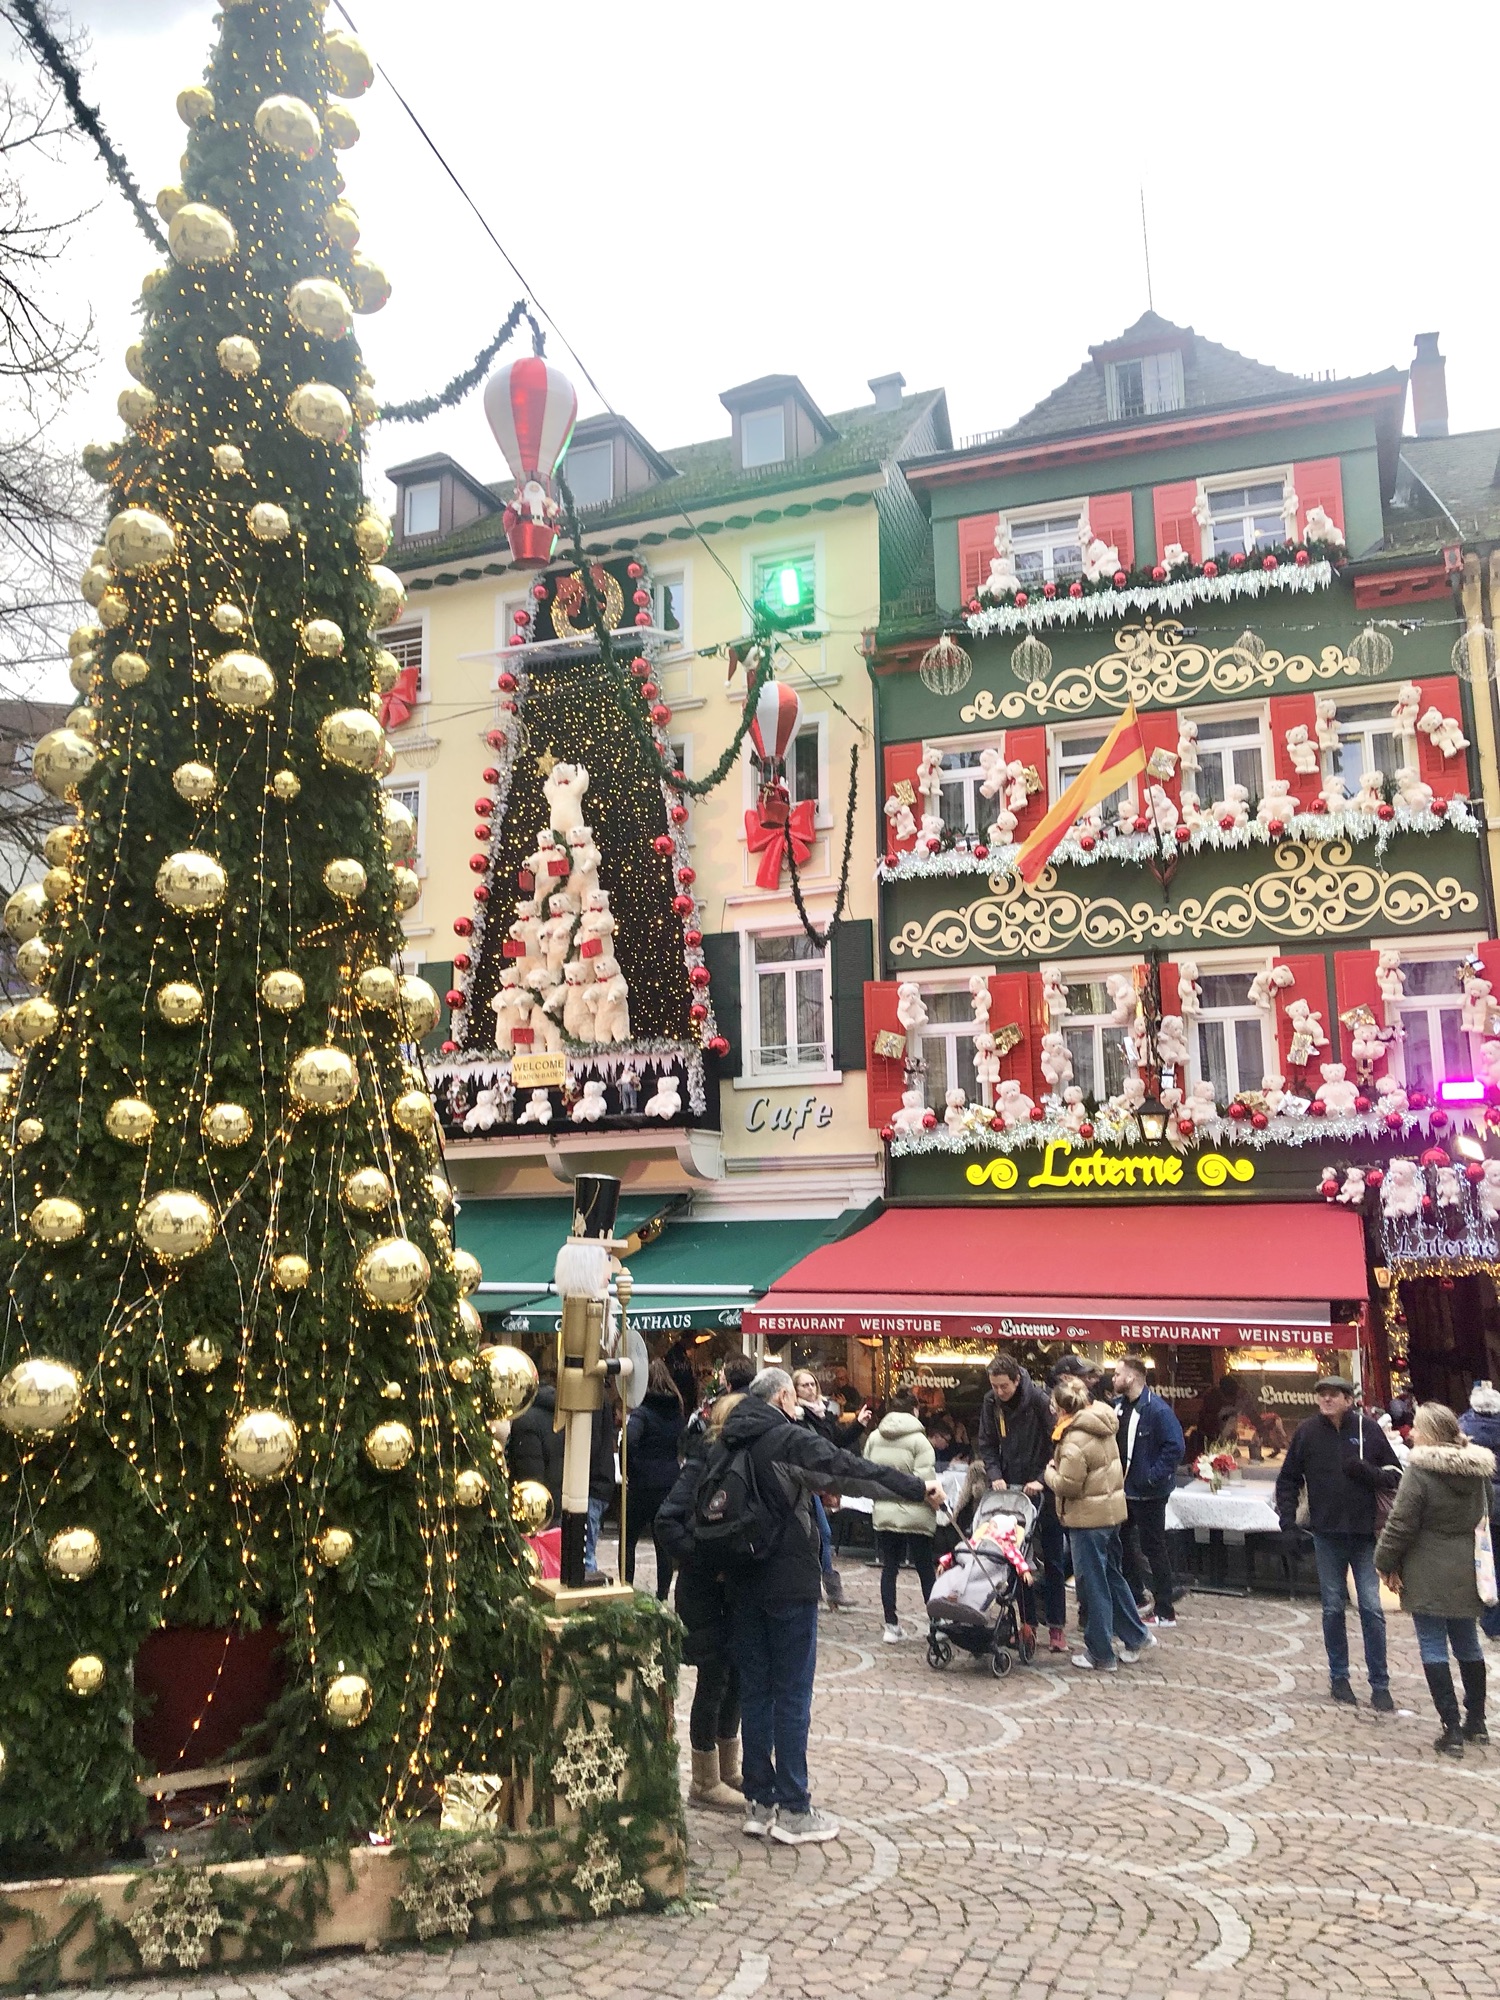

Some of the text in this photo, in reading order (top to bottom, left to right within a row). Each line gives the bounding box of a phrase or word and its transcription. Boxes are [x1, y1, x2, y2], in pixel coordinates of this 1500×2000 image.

[513, 1060, 564, 1072] WELCOME
[1028, 1139, 1184, 1188] Laterne
[759, 1317, 1334, 1345] RESTAURANT WEINSTUBE Laterne RESTAURANT WEINSTUBE
[900, 1369, 961, 1390] Laterne
